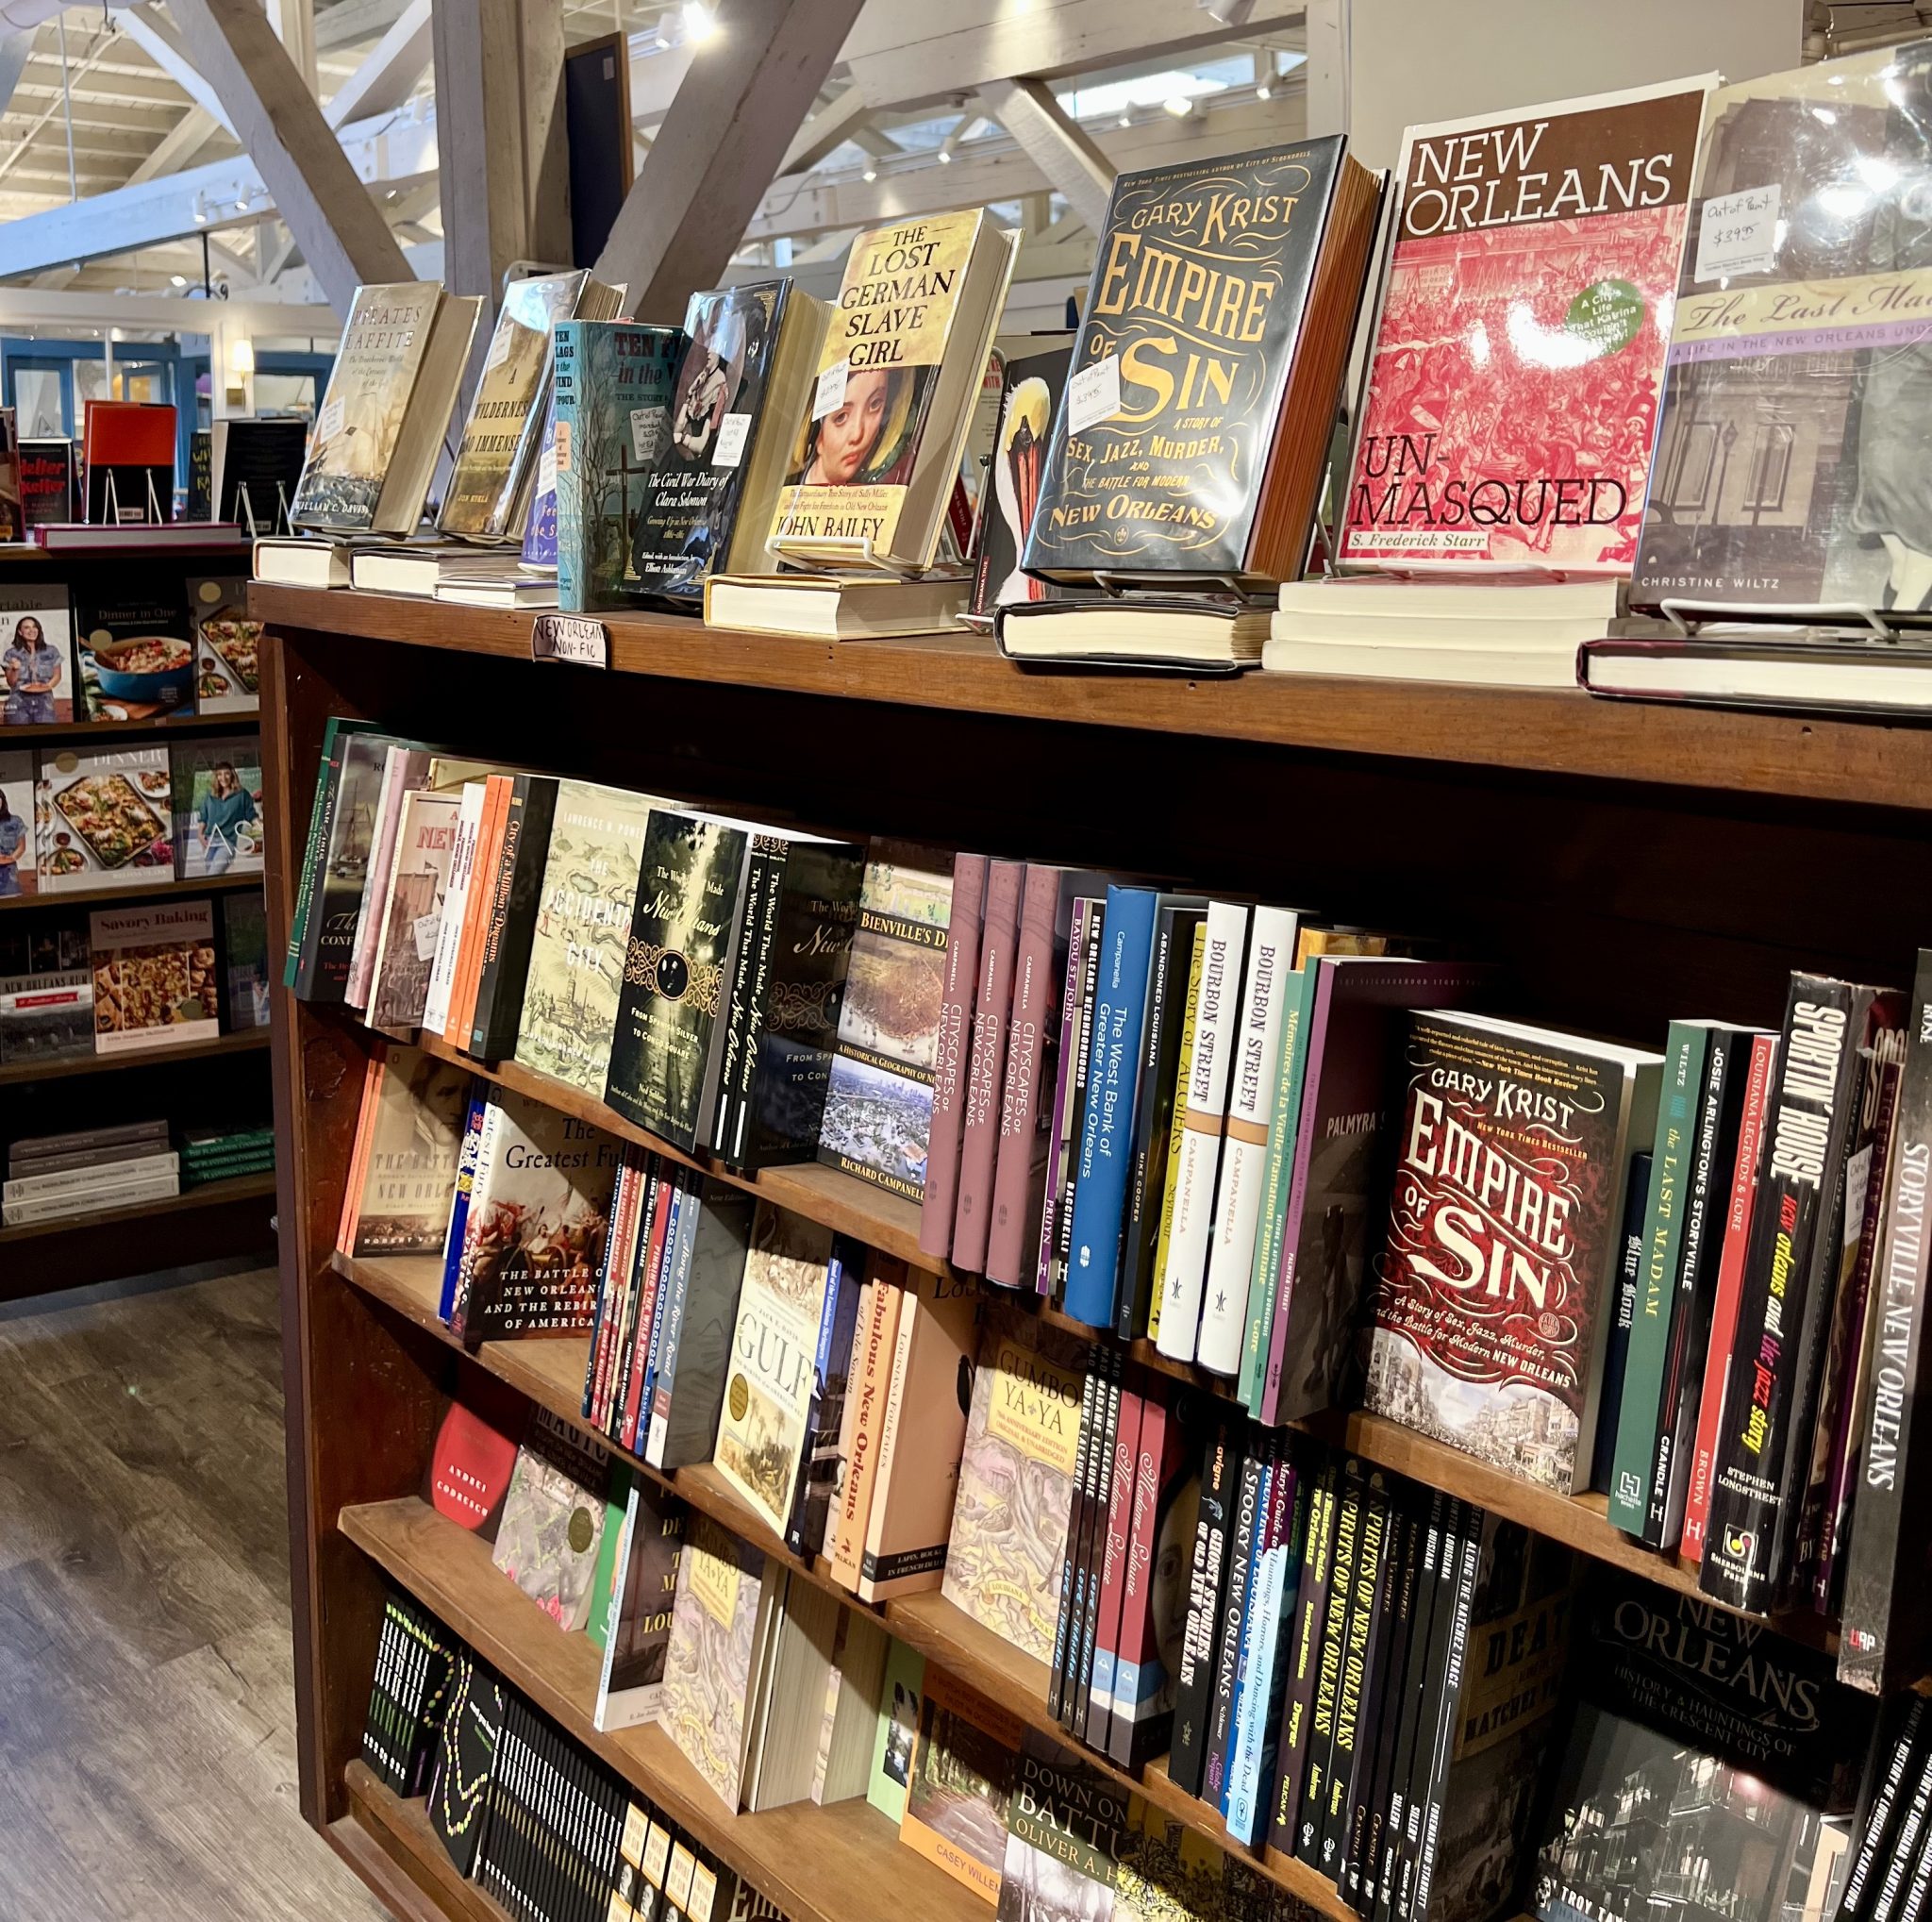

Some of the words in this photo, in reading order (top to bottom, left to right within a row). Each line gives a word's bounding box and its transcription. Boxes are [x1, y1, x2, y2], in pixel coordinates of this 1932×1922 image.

[1411, 123, 1549, 188] NEW
[1405, 154, 1675, 237] ORLEANS
[893, 226, 927, 246] THE
[1132, 200, 1202, 229] GARY
[1199, 192, 1300, 247] KRIST
[869, 242, 940, 276] LOST
[841, 270, 955, 310] GERMAN
[1094, 231, 1275, 343] EMPIRE
[353, 307, 422, 326] PIRATES
[845, 305, 927, 337] SLAVE
[1592, 304, 1612, 315] Life
[345, 331, 414, 349] LAFFITE
[849, 339, 904, 366] GIRL
[1674, 346, 1681, 358] A
[1687, 343, 1714, 356] LIFE
[1721, 341, 1735, 352] IN
[1740, 339, 1769, 350] THE
[1775, 334, 1806, 346] NEW
[1812, 327, 1888, 344] ORLEANS
[508, 369, 515, 384] A
[1174, 418, 1180, 430] A
[1182, 417, 1208, 429] STORY
[1209, 416, 1224, 428] OF
[1129, 461, 1149, 471] AND
[1364, 433, 1451, 478] UN-
[649, 473, 660, 487] The
[661, 472, 678, 487] Civil
[681, 473, 695, 487] War
[696, 473, 718, 490] Diary
[720, 471, 732, 491] of
[656, 491, 677, 506] Clara
[679, 491, 708, 506] Solomon
[1098, 476, 1130, 489] BATTLE
[1132, 476, 1148, 487] FOR
[1152, 475, 1190, 487] MODERN
[1046, 504, 1101, 528] NEW
[1107, 493, 1215, 529] ORLEANS
[1350, 479, 1628, 526] MASQUED
[776, 516, 816, 536] JOHN
[824, 518, 884, 541] BAILEY
[1350, 534, 1366, 547] S.
[1369, 533, 1439, 548] Frederick
[1442, 533, 1486, 549] Starr
[1641, 576, 1725, 589] CHRISTINE
[1732, 577, 1780, 589] WILTZ
[98, 609, 137, 621] Dinner
[141, 609, 151, 620] in
[153, 608, 178, 620] One
[94, 748, 163, 766] DINNER
[657, 866, 669, 879] The
[706, 880, 724, 896] Made
[749, 868, 761, 890] The
[100, 913, 151, 931] Savory
[154, 910, 208, 925] Baking
[745, 891, 758, 928] World
[1092, 914, 1101, 940] NEW
[567, 941, 605, 973] CITY
[741, 929, 754, 953] That
[1067, 918, 1083, 961] BAYOU
[5, 980, 22, 993] NEW
[25, 978, 65, 990] ORLEANS
[67, 975, 89, 987] RUM
[737, 955, 750, 989] Made
[949, 940, 959, 992] CAMPANELLA
[1067, 963, 1077, 980] ST.
[1086, 942, 1097, 994] ORLEANS
[1202, 938, 1226, 1025] BOURBON
[732, 986, 745, 1030] New
[1064, 982, 1075, 1022] JOHN
[1092, 1003, 1111, 1061] Greater
[1112, 1006, 1128, 1037] The
[723, 1027, 742, 1086] Orleans
[943, 1004, 962, 1095] CITYSCAPES
[1076, 996, 1092, 1089] NEIGHBORHOODS
[1107, 1041, 1125, 1082] West
[1192, 1028, 1216, 1103] STREET
[943, 1096, 949, 1111] OF
[1090, 1067, 1105, 1110] New
[1102, 1087, 1119, 1131] Bank
[1326, 1111, 1376, 1139] PALMYRA
[562, 1117, 595, 1140] The
[1082, 1112, 1100, 1178] Orleans
[1476, 1122, 1493, 1132] NEW
[1495, 1126, 1515, 1139] YORK
[1518, 1132, 1540, 1146] TIMES
[1542, 1139, 1588, 1160] BESTSELLER
[506, 1145, 590, 1169] Greatest
[1100, 1136, 1112, 1158] of
[1059, 1181, 1076, 1253] BACCINELLI
[1134, 1180, 1143, 1223] COOPER
[1042, 1199, 1056, 1245] PRUYN
[500, 1271, 528, 1280] THE
[534, 1268, 588, 1279] BATTLE
[648, 1244, 660, 1282] FINDING
[675, 1234, 691, 1280] Along
[1407, 1205, 1552, 1312] SIN
[485, 1303, 513, 1313] AND
[519, 1302, 548, 1312] THE
[504, 1286, 534, 1297] NEW
[675, 1281, 684, 1302] the
[1282, 1279, 1291, 1312] STREET
[505, 1318, 524, 1329] OF
[527, 1317, 594, 1329] AMERICA
[641, 1303, 650, 1337] WILD
[670, 1304, 683, 1336] River
[866, 1281, 889, 1377] Fabulous
[1251, 1320, 1262, 1353] Gore
[1394, 1295, 1407, 1306] A
[1407, 1298, 1434, 1318] Story
[1435, 1309, 1446, 1322] of
[1445, 1311, 1466, 1333] Sex,
[1466, 1321, 1498, 1344] Jazz,
[1500, 1333, 1545, 1361] Murder,
[636, 1338, 646, 1374] WEST
[664, 1337, 676, 1377] Road
[738, 1312, 812, 1400] GULF
[1386, 1308, 1402, 1325] the
[1404, 1312, 1434, 1338] Battle
[1435, 1326, 1447, 1344] for
[1449, 1332, 1490, 1359] Modern
[1492, 1350, 1519, 1368] NEW
[1520, 1359, 1571, 1388] ORLEANS
[1000, 1348, 1080, 1409] GUMBO
[859, 1381, 876, 1427] New
[1004, 1380, 1027, 1415] YA
[1038, 1400, 1064, 1436] YA
[448, 1464, 487, 1493] ANDREI
[846, 1430, 869, 1521] Orleans
[1654, 1434, 1671, 1496] CRANDLE
[1691, 1449, 1709, 1507] BROWN
[1726, 1464, 1775, 1492] STEPHEN
[437, 1480, 489, 1517] CODRESCU
[1717, 1475, 1783, 1508] LONGSTREET
[1240, 1470, 1258, 1550] SPOOKY
[1209, 1527, 1224, 1576] GHOST
[1463, 1540, 1476, 1572] ALONG
[1230, 1553, 1245, 1602] NEW
[1459, 1574, 1471, 1598] THE
[1196, 1577, 1219, 1664] STORIES
[1452, 1599, 1468, 1658] NATCHEZ
[1220, 1605, 1236, 1699] ORLEANS
[1447, 1659, 1458, 1690] TRACE
[1290, 1700, 1303, 1749] Dwyer
[1016, 1817, 1079, 1864] OLIVER
[1084, 1857, 1100, 1875] A.
